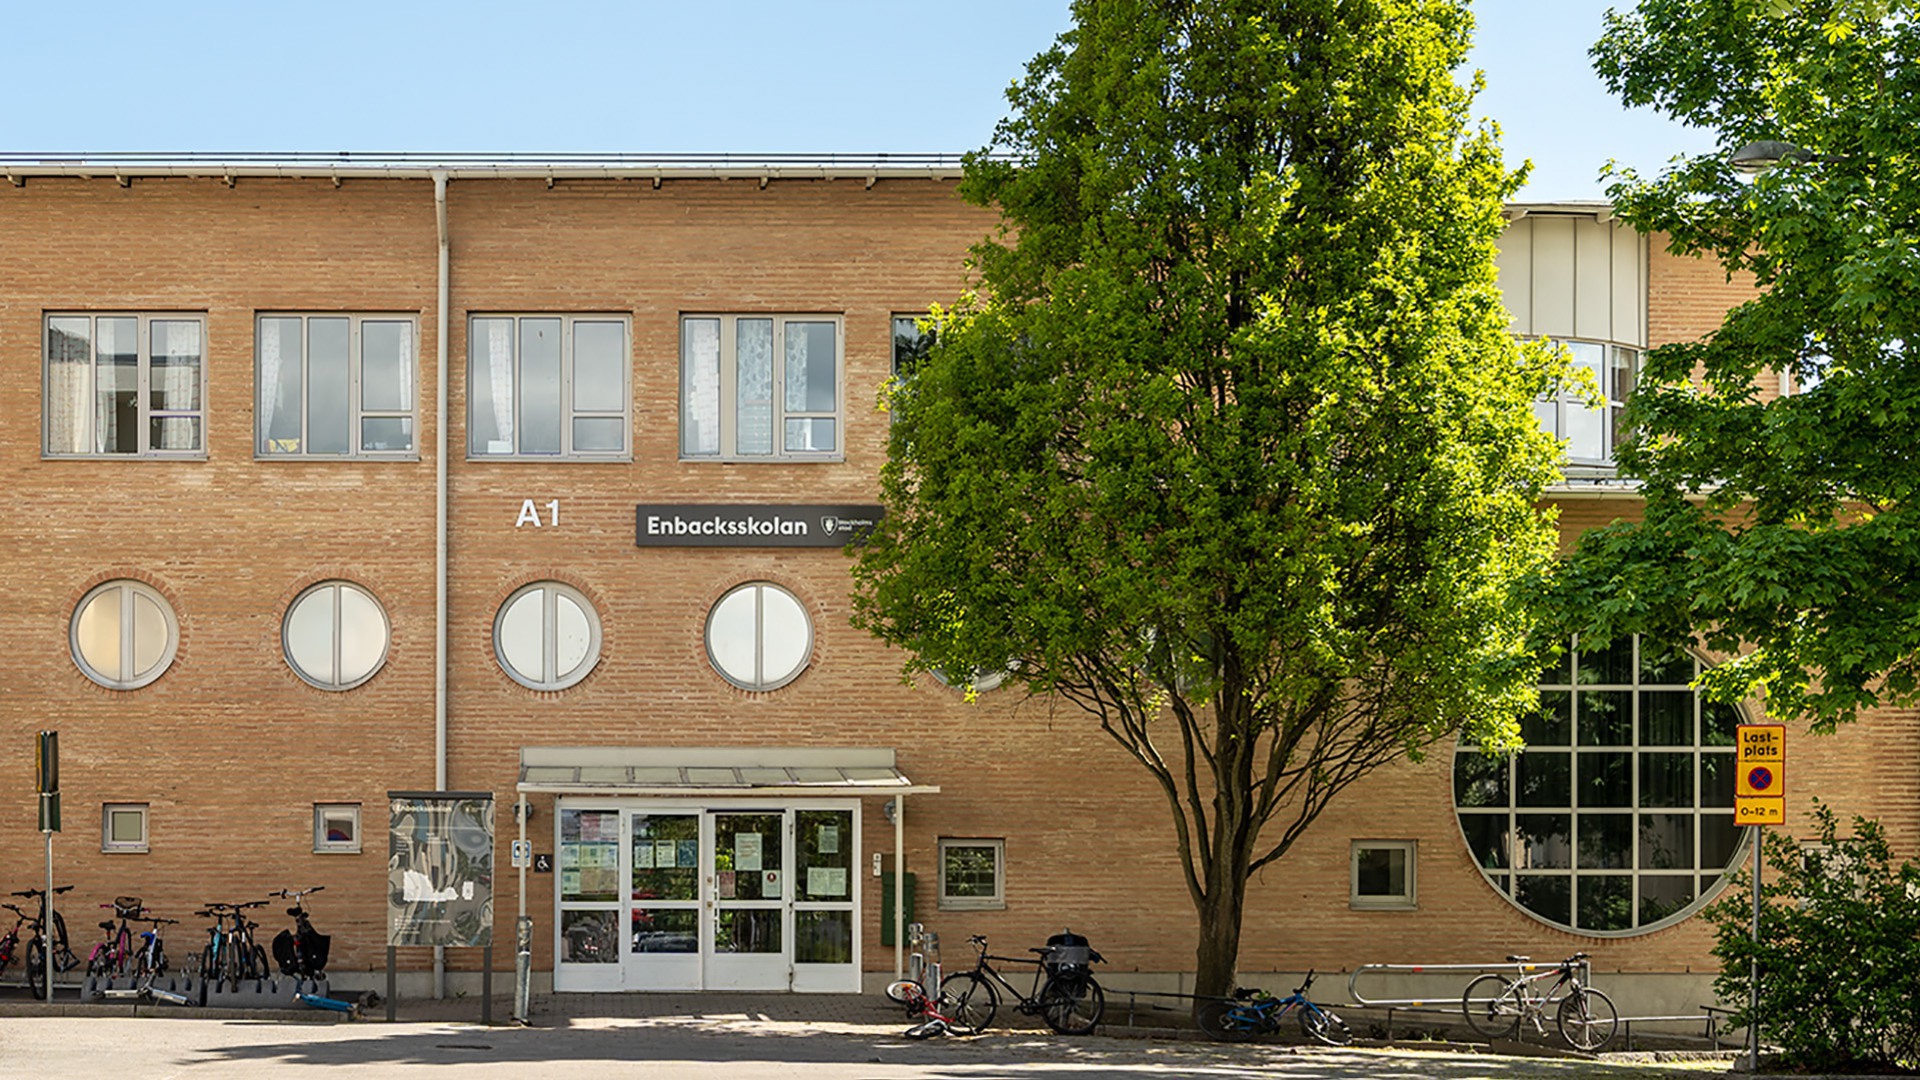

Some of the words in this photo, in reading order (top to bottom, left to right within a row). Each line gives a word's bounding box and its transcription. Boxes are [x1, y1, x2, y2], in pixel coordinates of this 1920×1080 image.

[515, 499, 560, 527] A1
[647, 516, 808, 536] Enbacksskolan
[1743, 732, 1779, 743] Last-
[1744, 745, 1778, 758] plats
[1740, 807, 1766, 816] 0-12
